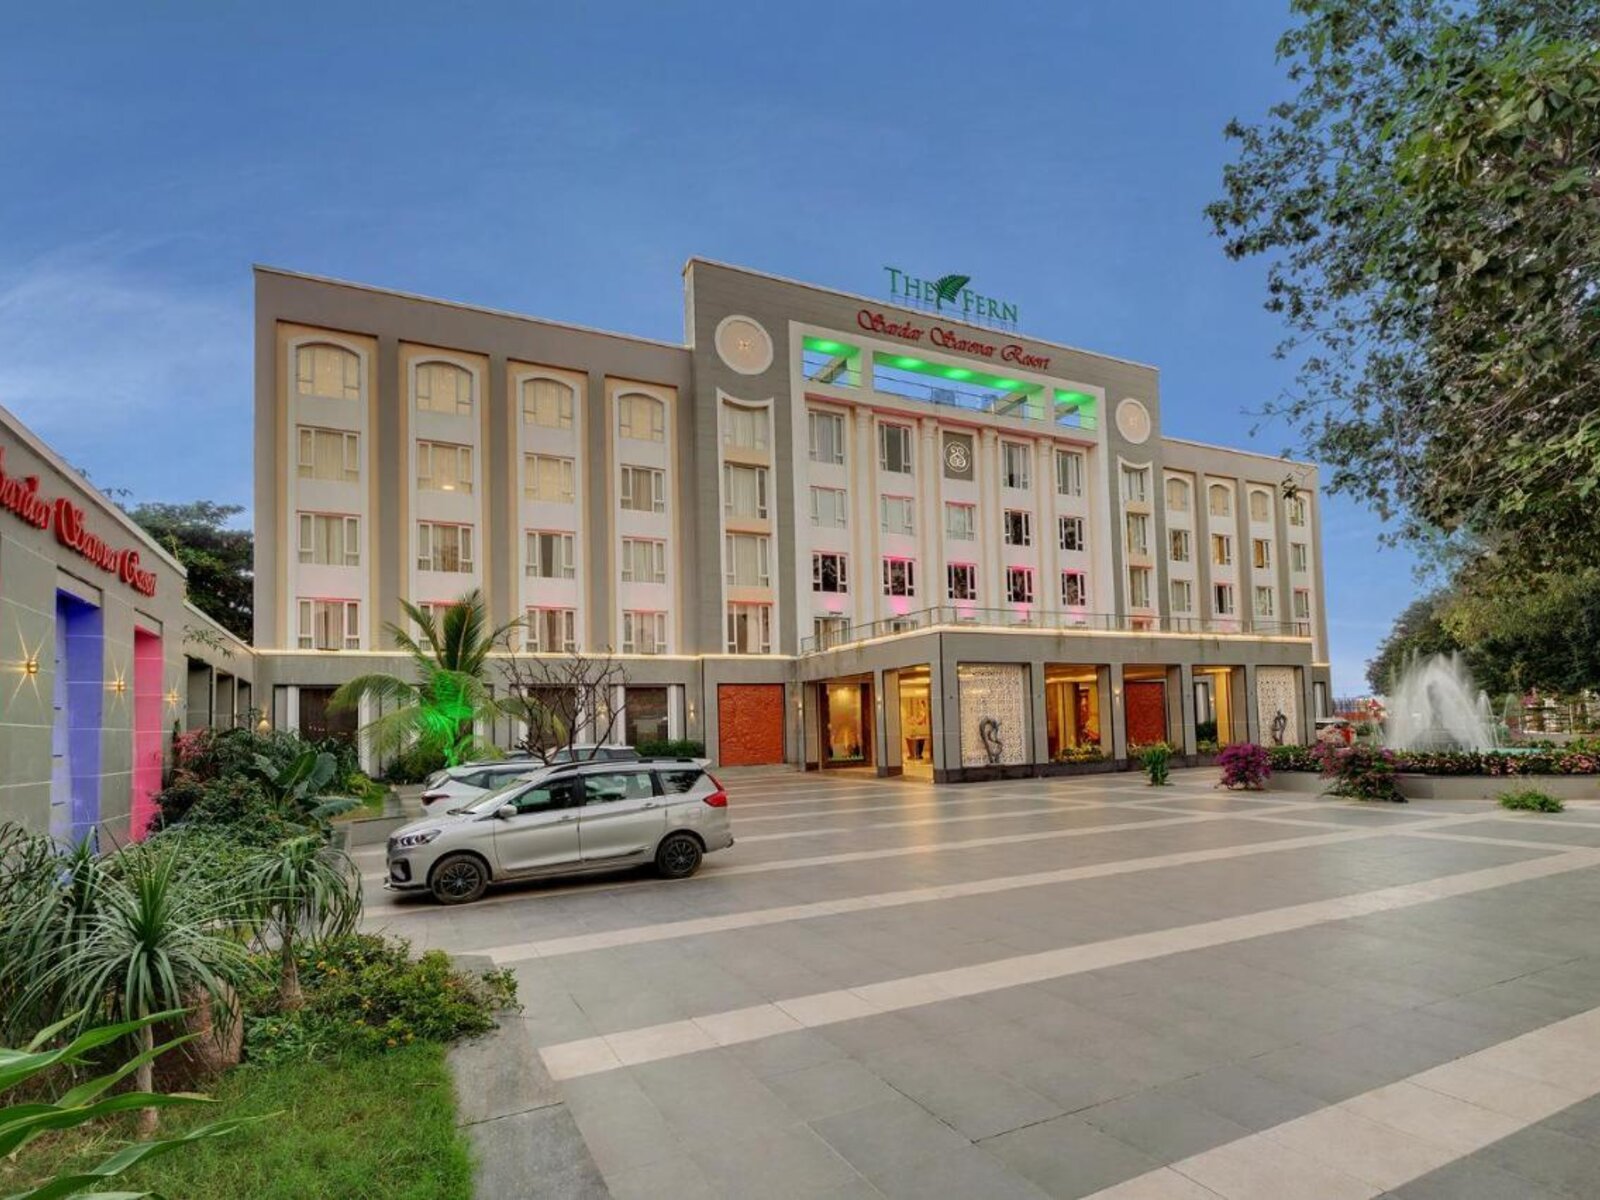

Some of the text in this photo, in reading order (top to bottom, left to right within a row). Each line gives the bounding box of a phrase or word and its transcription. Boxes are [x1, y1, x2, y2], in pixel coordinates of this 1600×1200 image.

[884, 267, 1018, 323] THE FERN
[857, 309, 924, 341] Sardar
[0, 446, 56, 530] ardar
